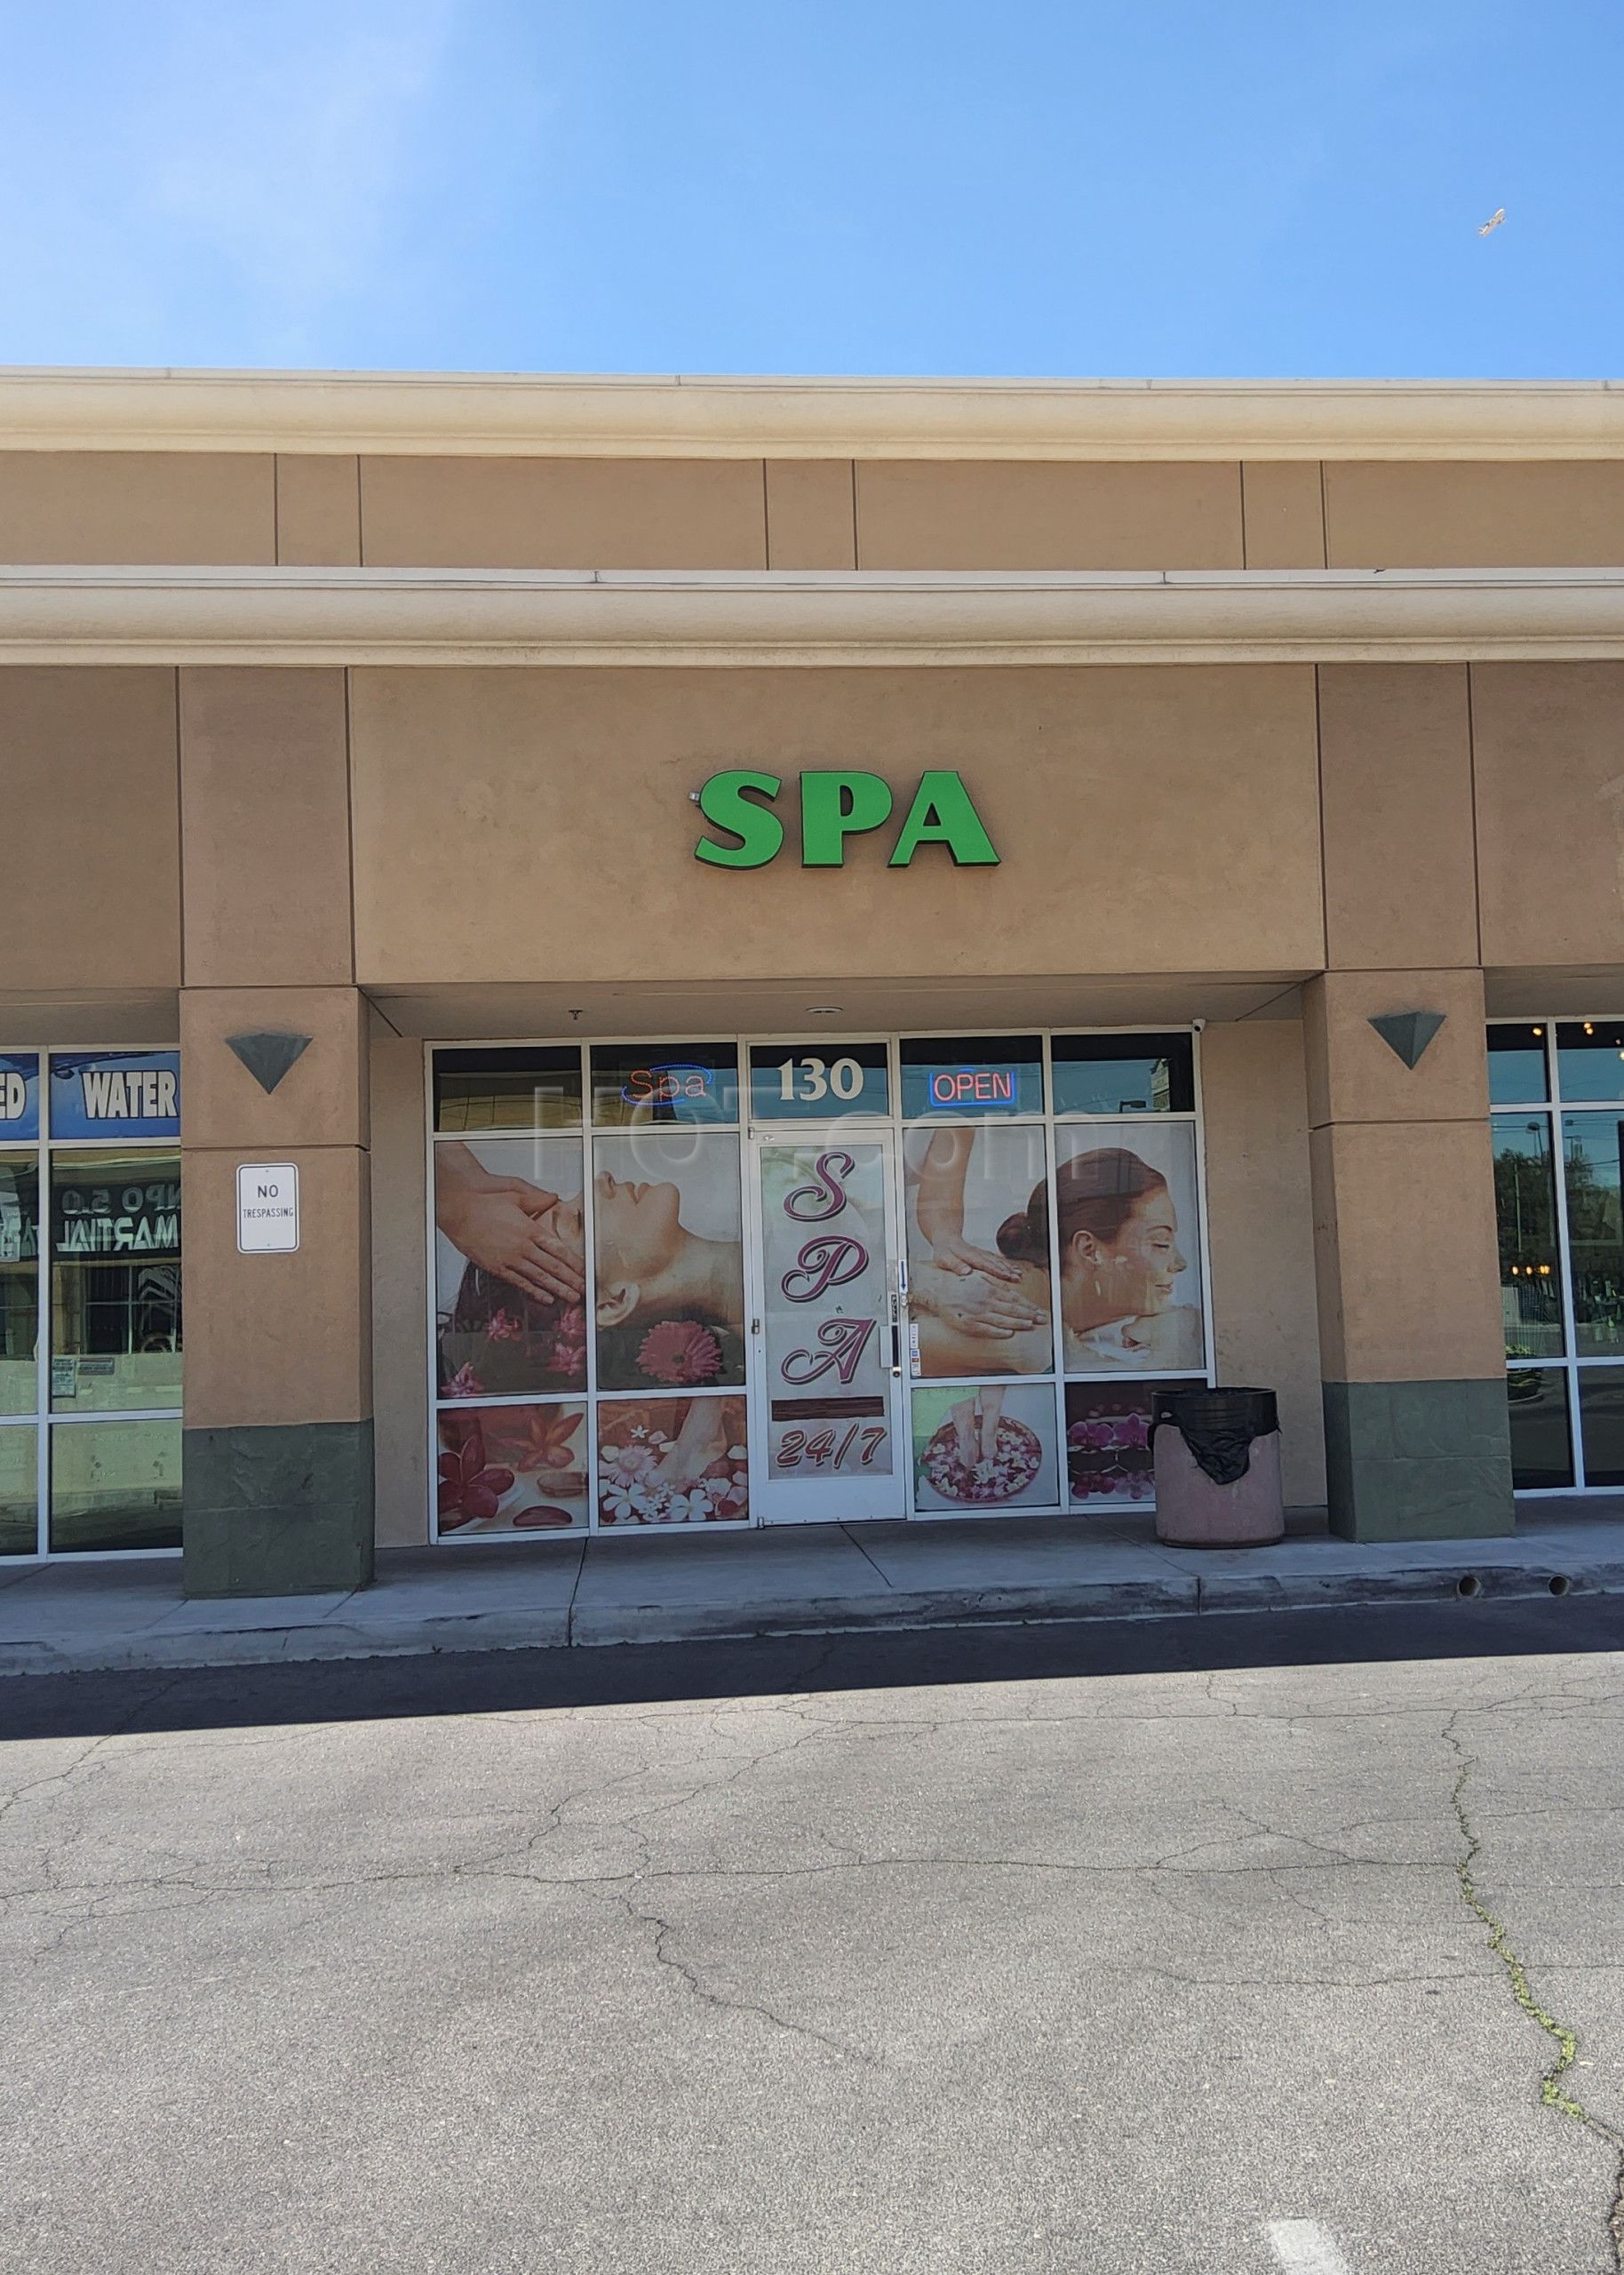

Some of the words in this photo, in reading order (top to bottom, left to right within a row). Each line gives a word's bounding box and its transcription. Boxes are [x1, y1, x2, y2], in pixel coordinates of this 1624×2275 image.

[694, 770, 1002, 870] SPA
[82, 1070, 179, 1119] WATER
[629, 1070, 707, 1101] Spa
[776, 1058, 864, 1102] 130
[934, 1072, 1012, 1102] OPEN
[258, 1185, 279, 1198] NO
[243, 1208, 294, 1218] TRESPASSING
[776, 1423, 887, 1468] 24/7
